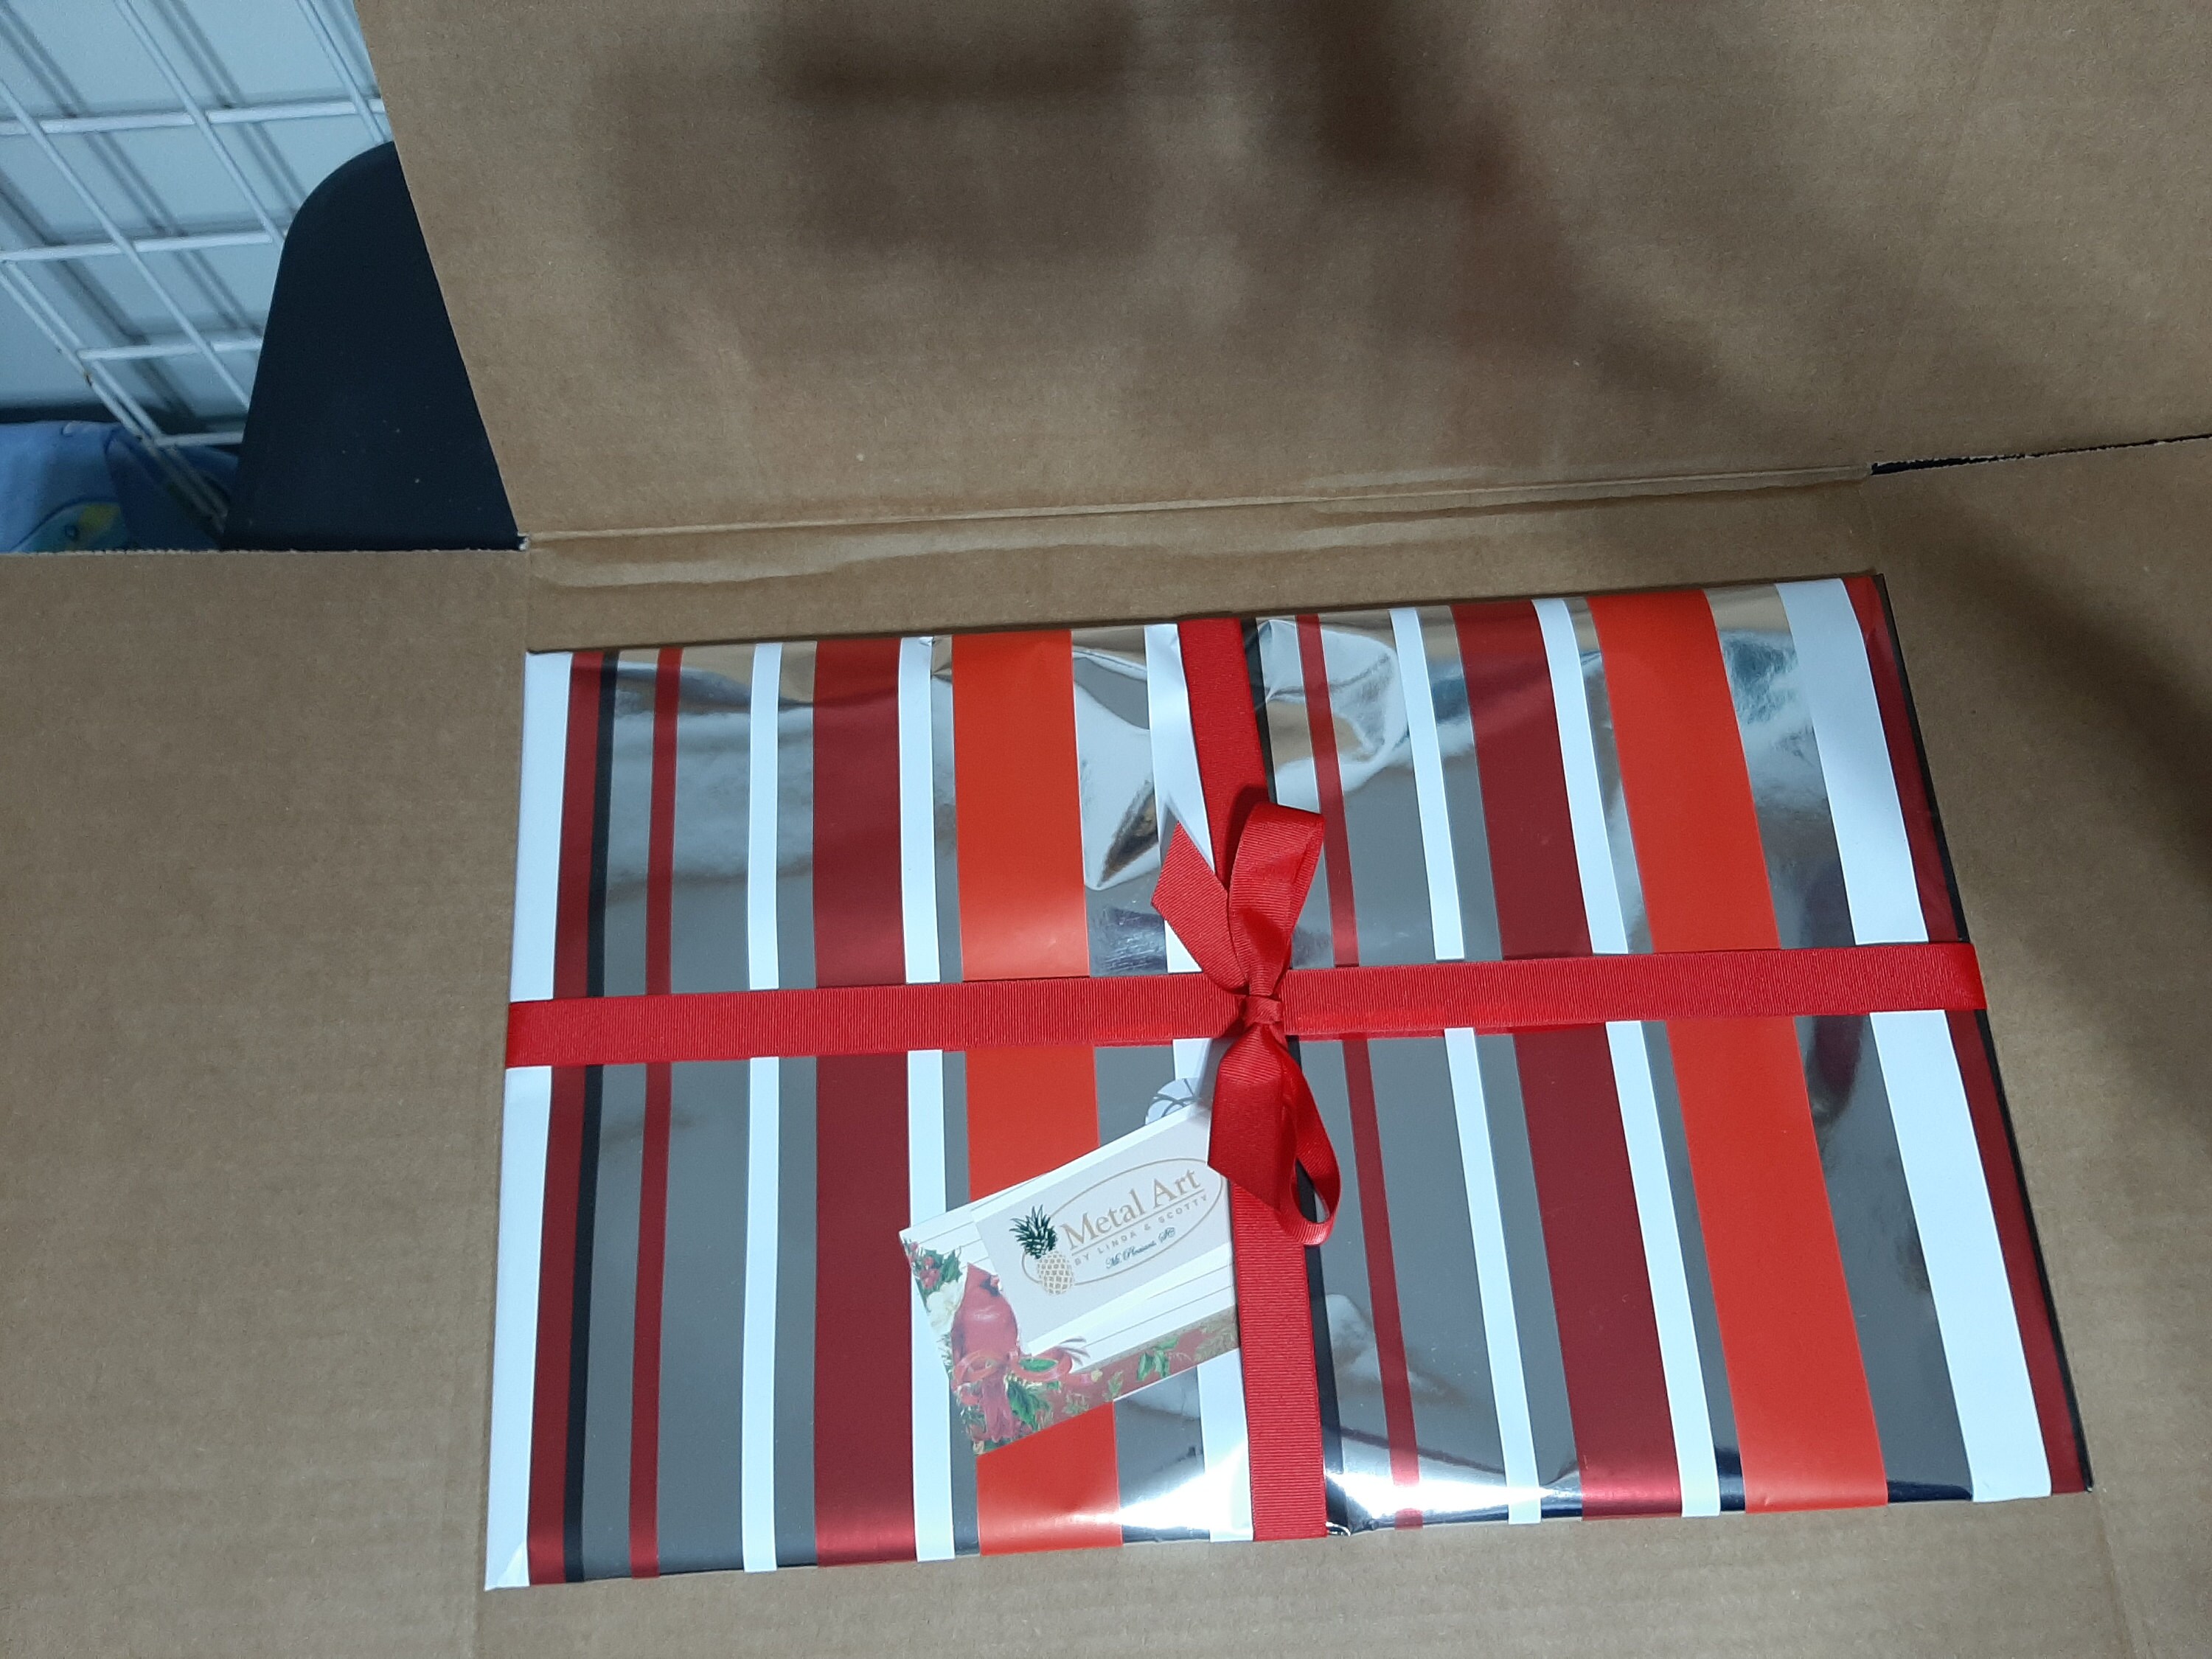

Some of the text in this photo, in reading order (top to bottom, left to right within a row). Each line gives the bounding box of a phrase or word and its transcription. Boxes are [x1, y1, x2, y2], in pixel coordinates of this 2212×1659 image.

[1060, 1169, 1201, 1251] Metal Art
[1074, 1194, 1208, 1266] BY LINDA & SCOTTY
